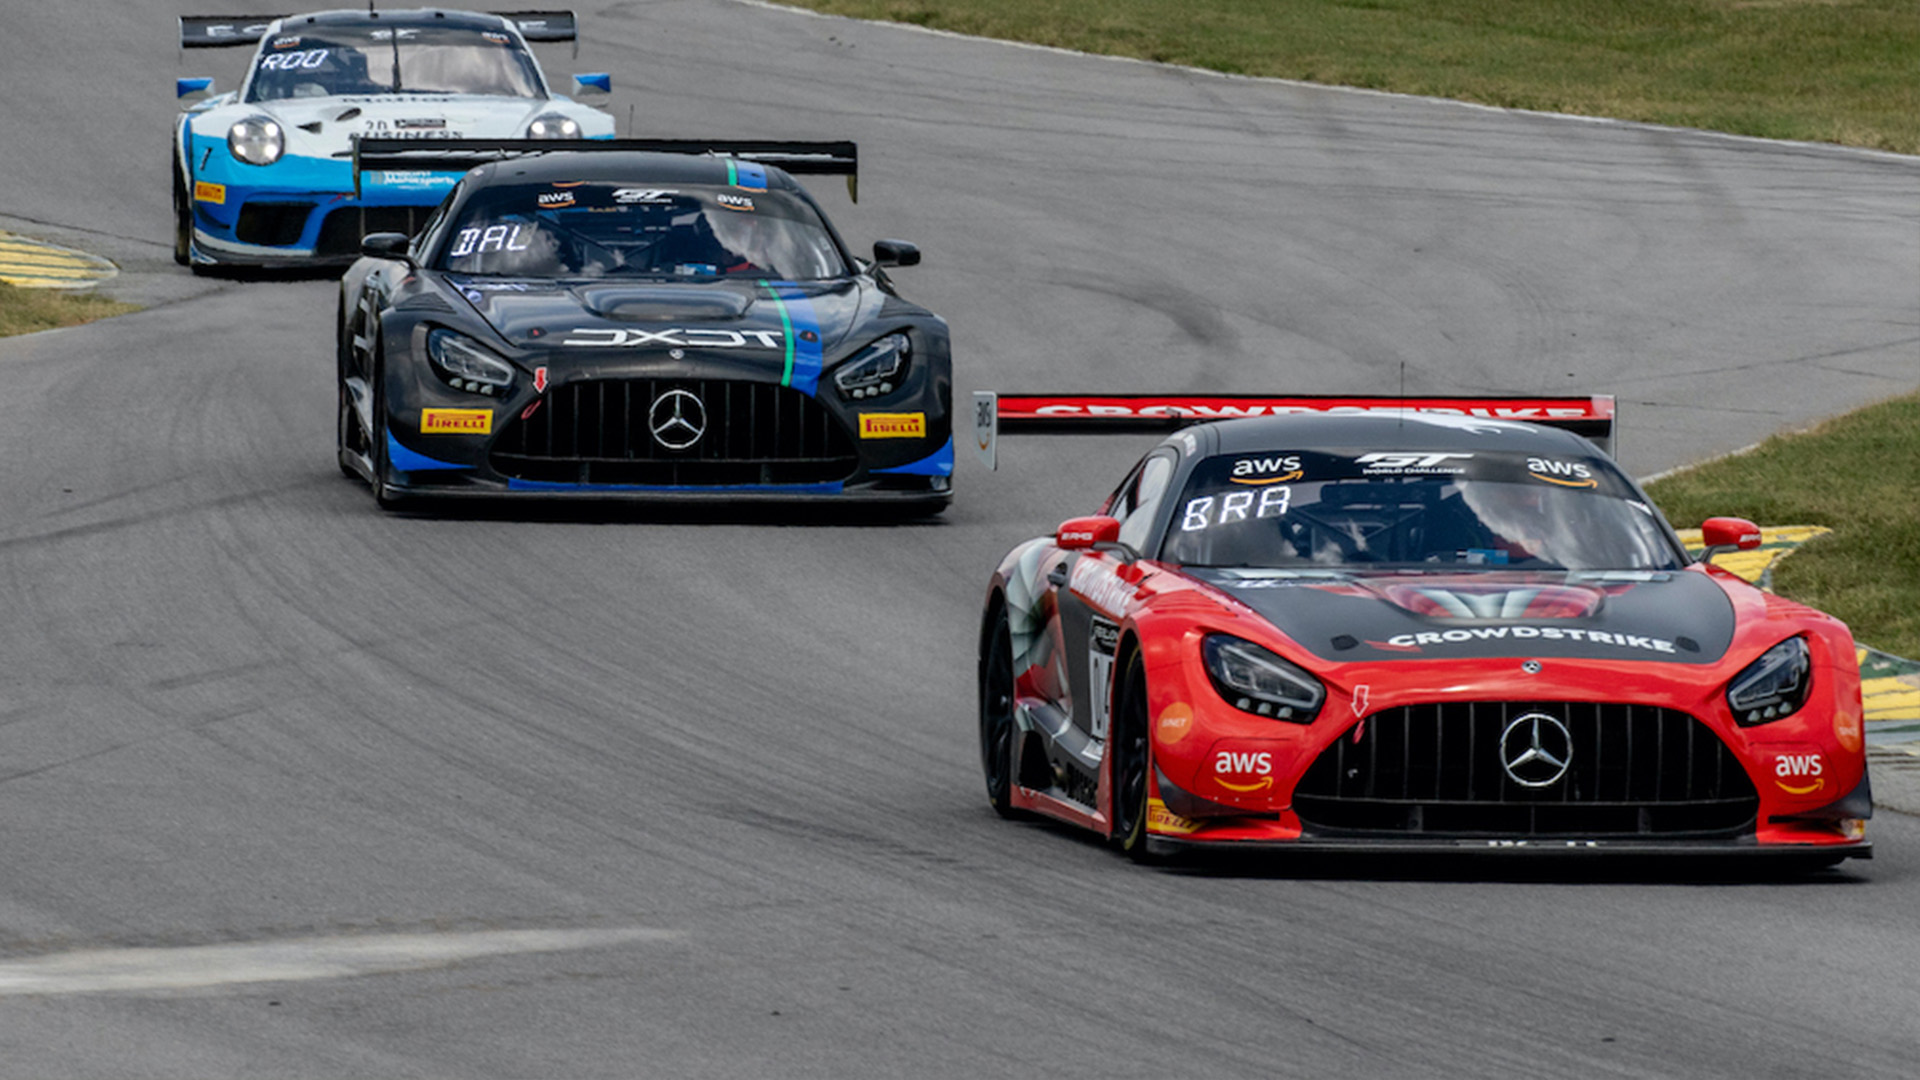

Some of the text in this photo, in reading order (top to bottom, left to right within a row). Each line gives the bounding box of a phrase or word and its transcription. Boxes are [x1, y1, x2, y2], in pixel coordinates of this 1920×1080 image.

[538, 191, 574, 203] aws
[717, 194, 753, 207] aws
[450, 225, 527, 256] DAL
[427, 413, 486, 429] PIRELLI
[1034, 405, 1587, 418] CROWDRIKE
[865, 419, 919, 432] PIRELLI
[1232, 456, 1301, 476] aws
[1404, 467, 1466, 475] CHALLENGE
[1527, 457, 1592, 478] aws
[1181, 485, 1291, 532] BRA
[1387, 626, 1677, 654] CROWDSTRIKE
[1215, 751, 1272, 775] aws
[1775, 754, 1823, 777] aws
